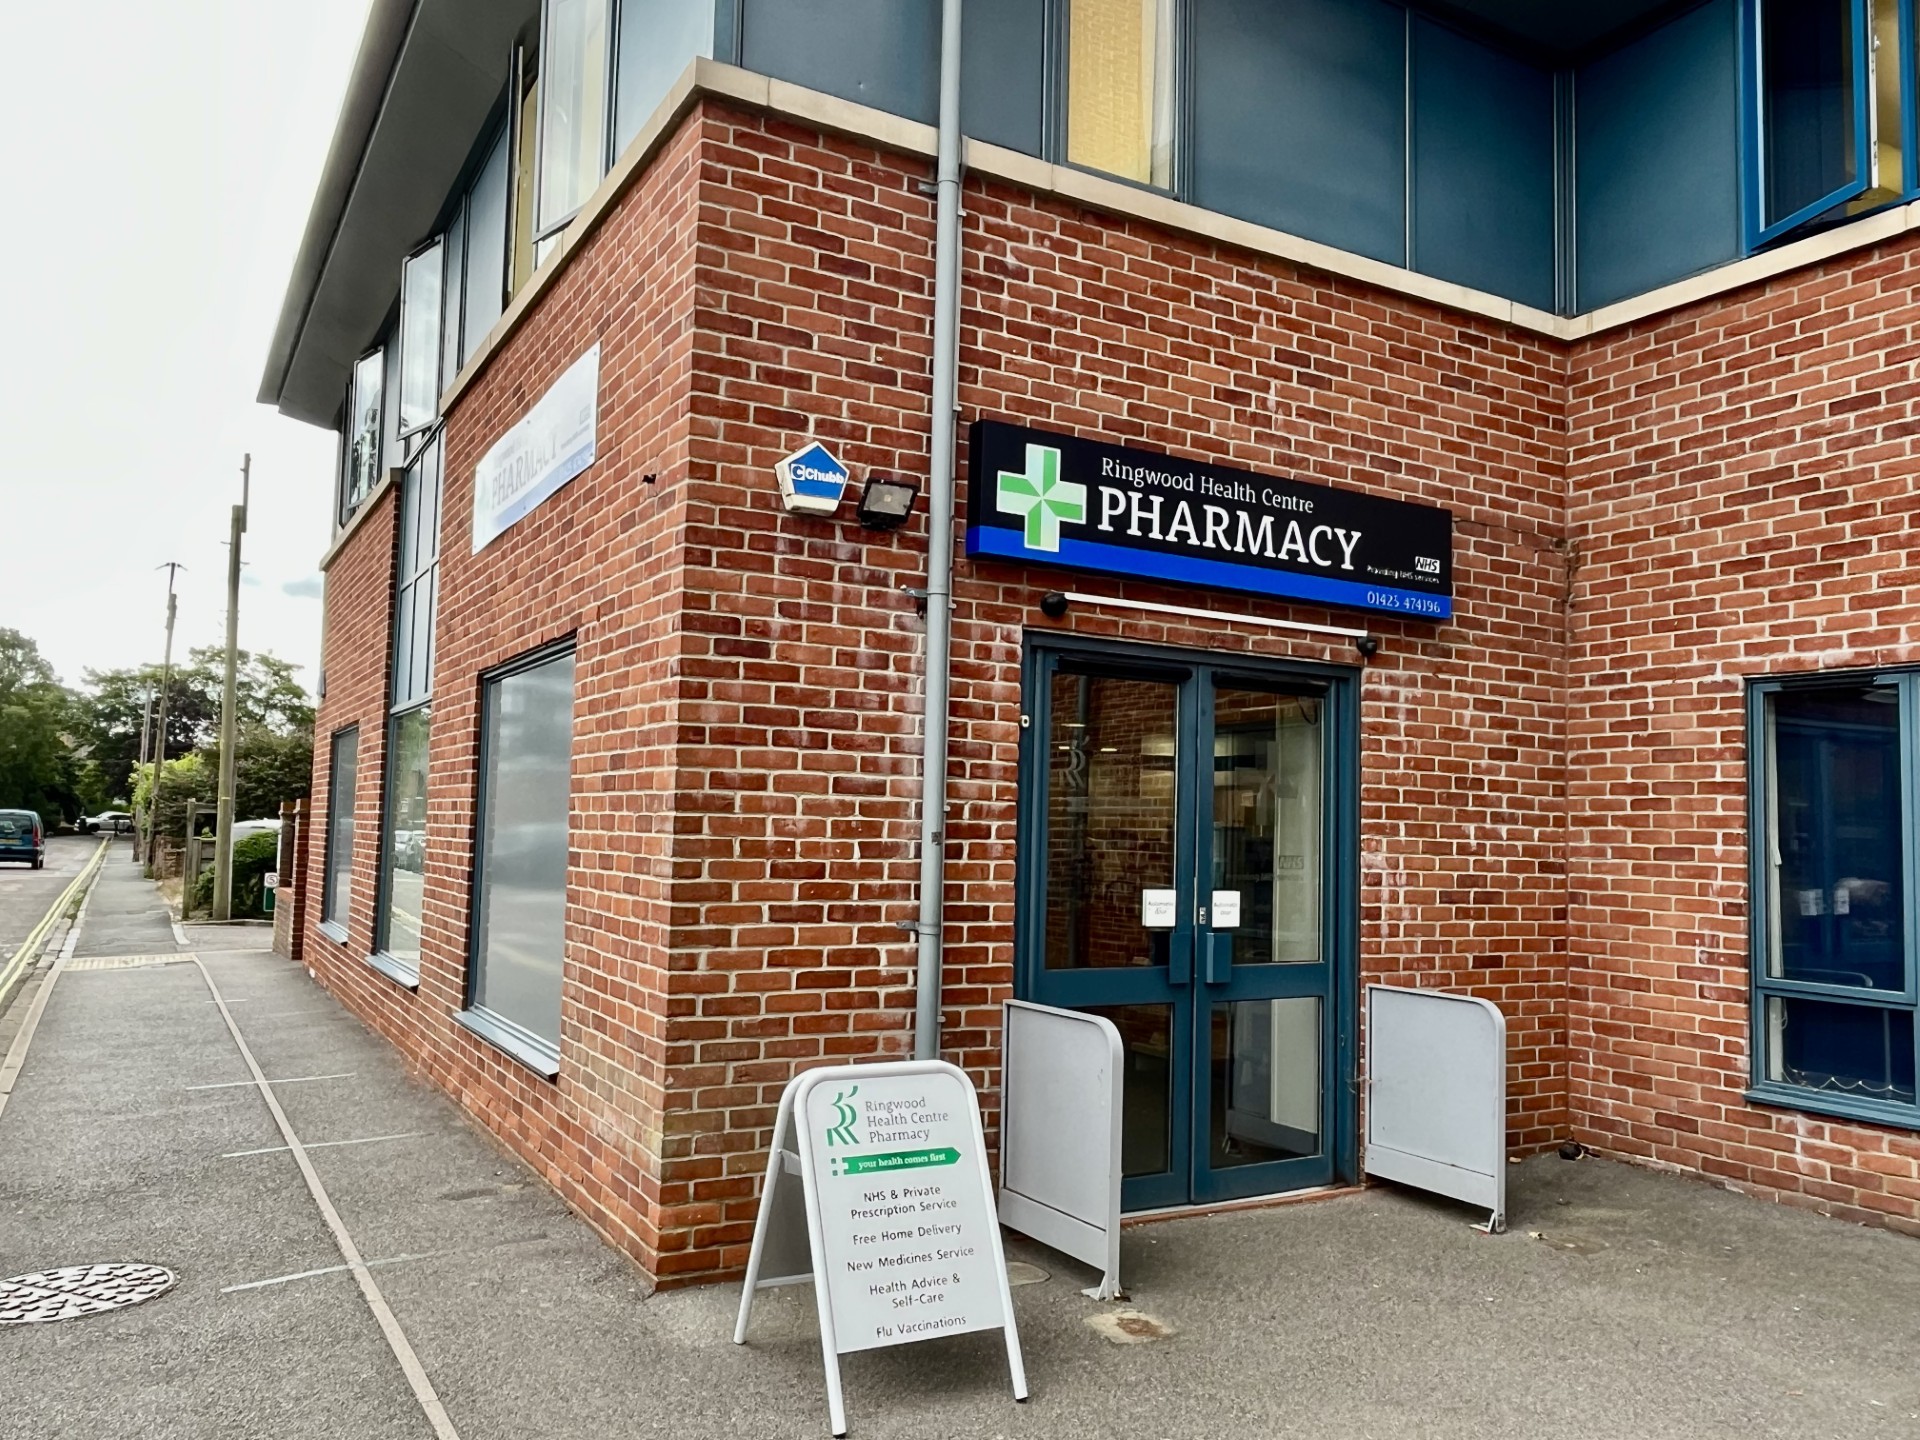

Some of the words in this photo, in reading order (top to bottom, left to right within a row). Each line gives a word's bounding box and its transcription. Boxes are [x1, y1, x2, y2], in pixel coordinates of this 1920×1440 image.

[805, 467, 845, 485] Chubb
[1101, 457, 1194, 488] Ringwood
[1200, 476, 1256, 504] Health
[1262, 489, 1314, 514] Centre
[1097, 485, 1362, 571] PHARMACY
[1415, 556, 1440, 573] NHS
[1367, 591, 1400, 608] 01425
[1403, 597, 1441, 613] 474196
[865, 1097, 926, 1113] Ringwood
[867, 1113, 907, 1128] Health
[911, 1112, 949, 1124] Centre
[869, 1129, 930, 1143] Pharmacy
[858, 1160, 877, 1171] your
[878, 1156, 904, 1168] health
[904, 1156, 929, 1165] comes
[929, 1152, 946, 1163] first
[864, 1191, 886, 1202] NHS
[890, 1190, 899, 1200] &
[903, 1186, 941, 1198] Private
[851, 1204, 916, 1219] Prescription
[919, 1199, 957, 1212] Service
[853, 1234, 877, 1245] Free
[881, 1231, 914, 1242] Home
[917, 1223, 962, 1238] Delivery
[847, 1260, 873, 1272] New
[878, 1252, 933, 1267] Medicines
[936, 1246, 975, 1260] Service
[869, 1281, 907, 1296] Health
[911, 1276, 948, 1290] Advice
[952, 1273, 961, 1284] &
[892, 1293, 945, 1309] Self-Care
[876, 1326, 893, 1338] Flu
[897, 1316, 967, 1334] Vaccinations
